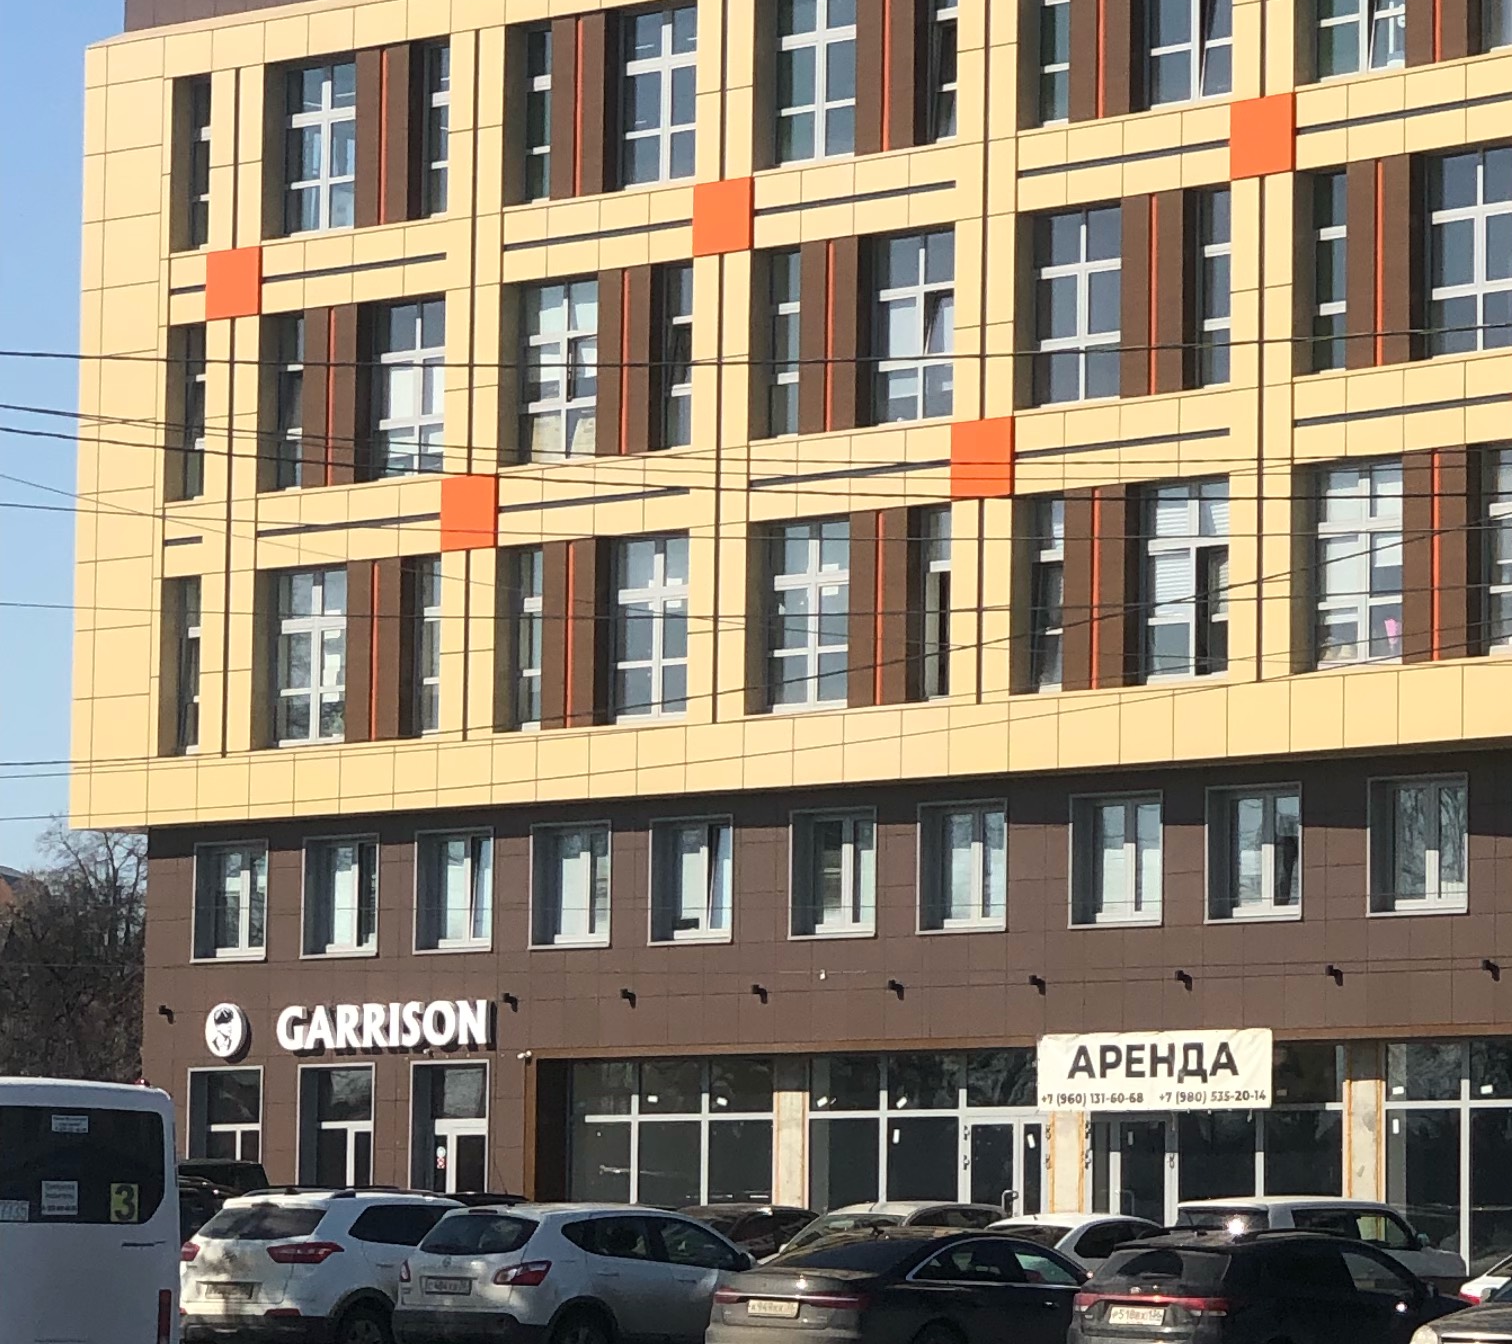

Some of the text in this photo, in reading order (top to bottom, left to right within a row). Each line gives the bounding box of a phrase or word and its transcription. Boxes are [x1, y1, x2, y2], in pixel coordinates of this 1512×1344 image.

[276, 999, 489, 1051] GARRISON
[1067, 1041, 1239, 1084] АРЕНДА
[1041, 1089, 1266, 1107] +7 (960) 131-60-68 +7 (980) 535-20-14
[115, 1184, 136, 1221] 3
